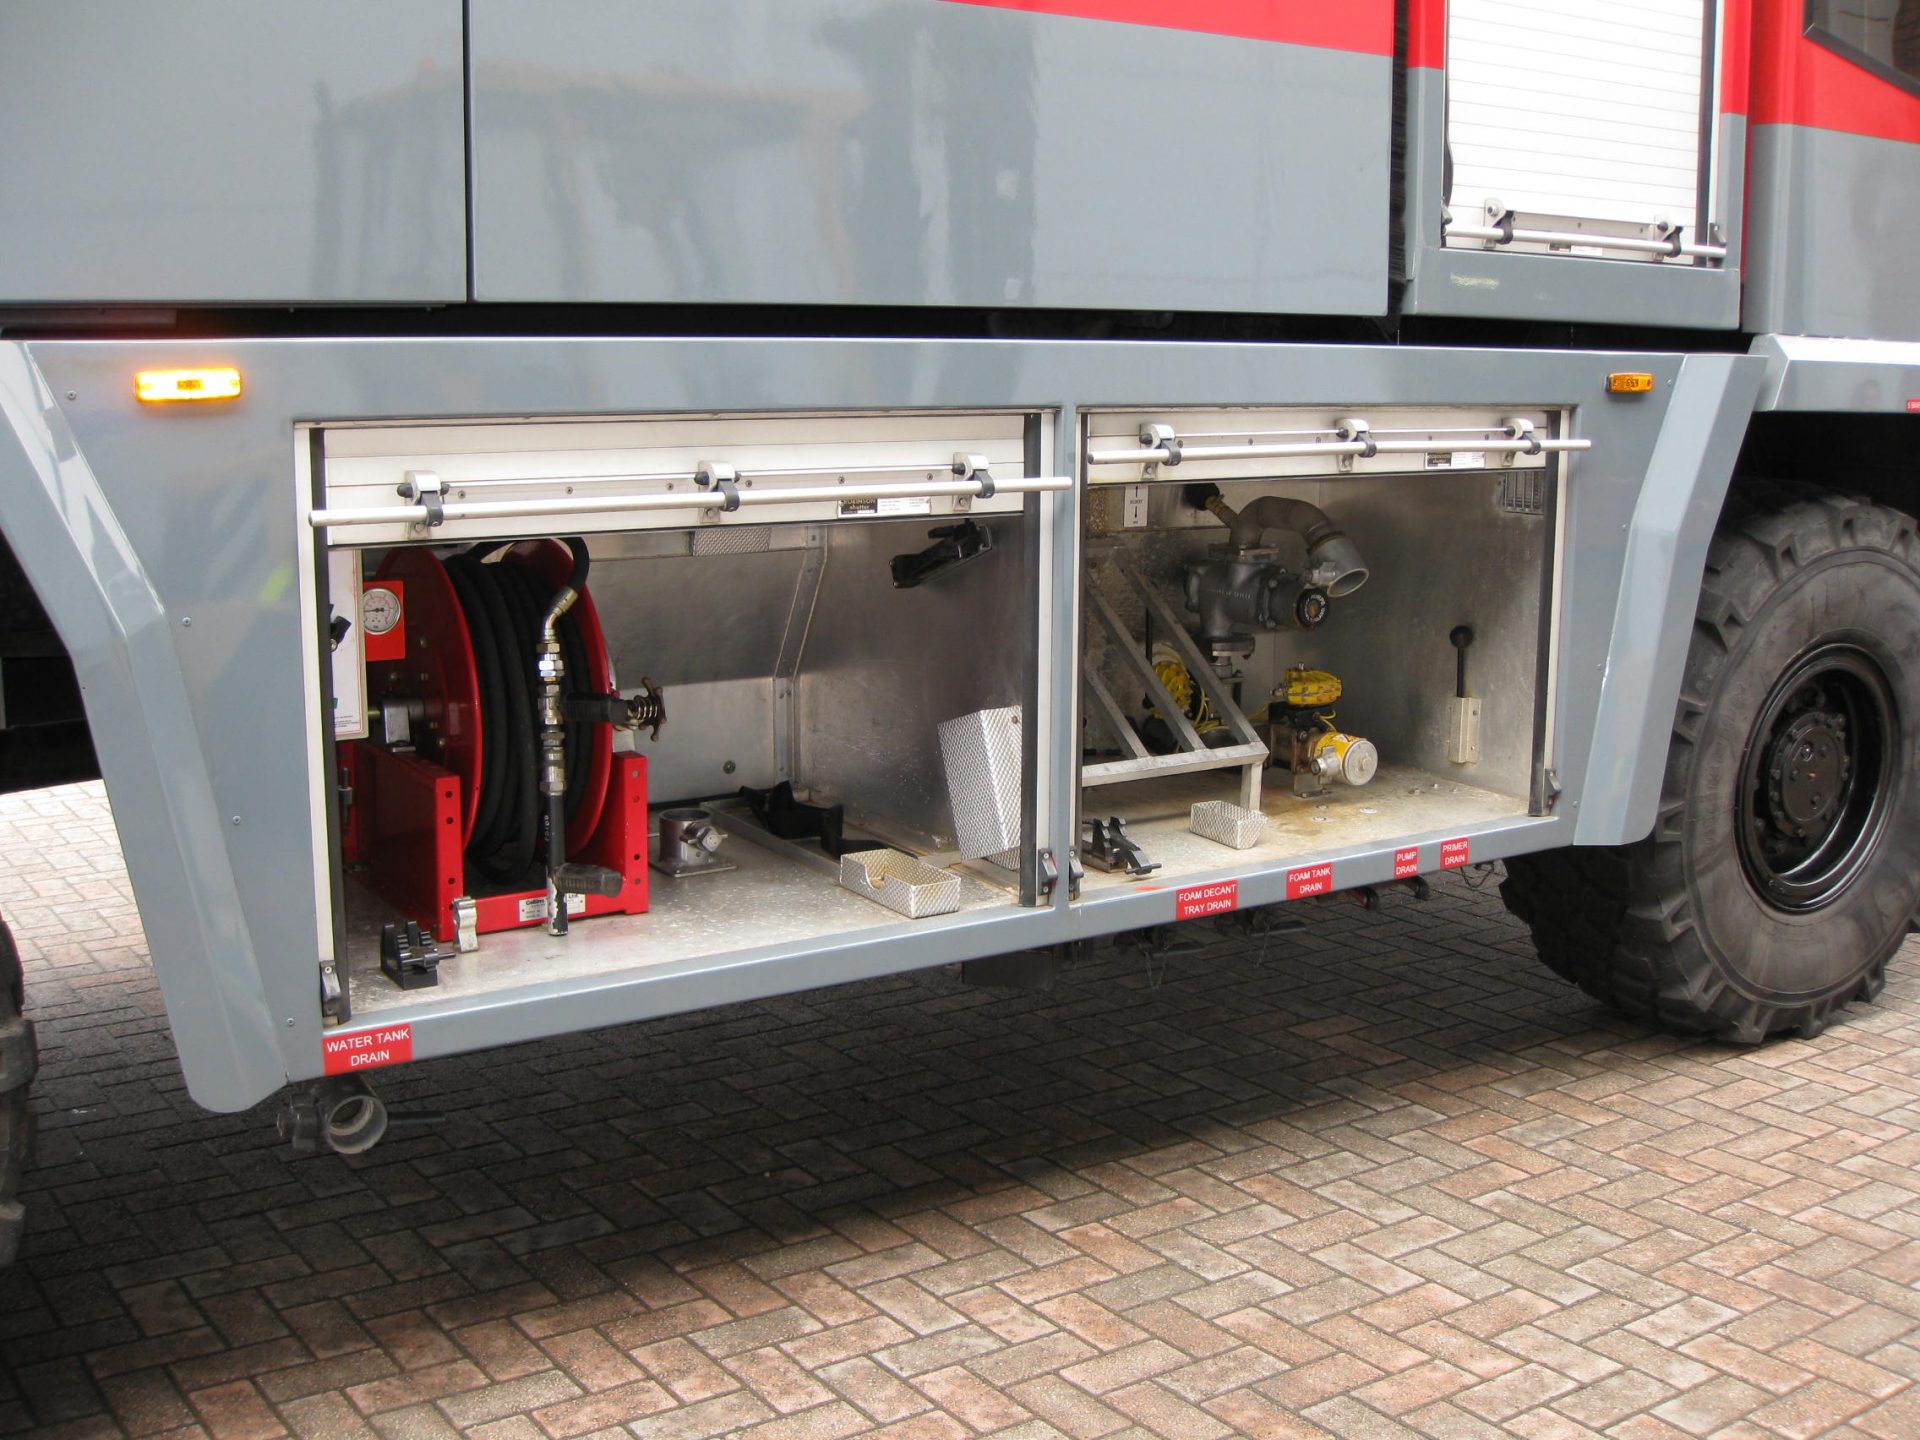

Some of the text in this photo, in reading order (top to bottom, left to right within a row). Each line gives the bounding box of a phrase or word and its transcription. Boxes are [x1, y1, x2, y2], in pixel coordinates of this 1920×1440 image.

[1442, 841, 1468, 853] PRIMER
[1396, 851, 1417, 863] PUMP
[1444, 855, 1466, 866] DRAIN
[1289, 867, 1331, 883] FOAM TANK
[1395, 864, 1417, 875] DRAIN
[1178, 884, 1237, 902] FOAM DECANT
[1299, 882, 1323, 894] DRAIN
[1184, 899, 1232, 915] TRAY DRAIN
[326, 1028, 410, 1053] WATER TANK
[350, 1049, 390, 1066] DRAIN
